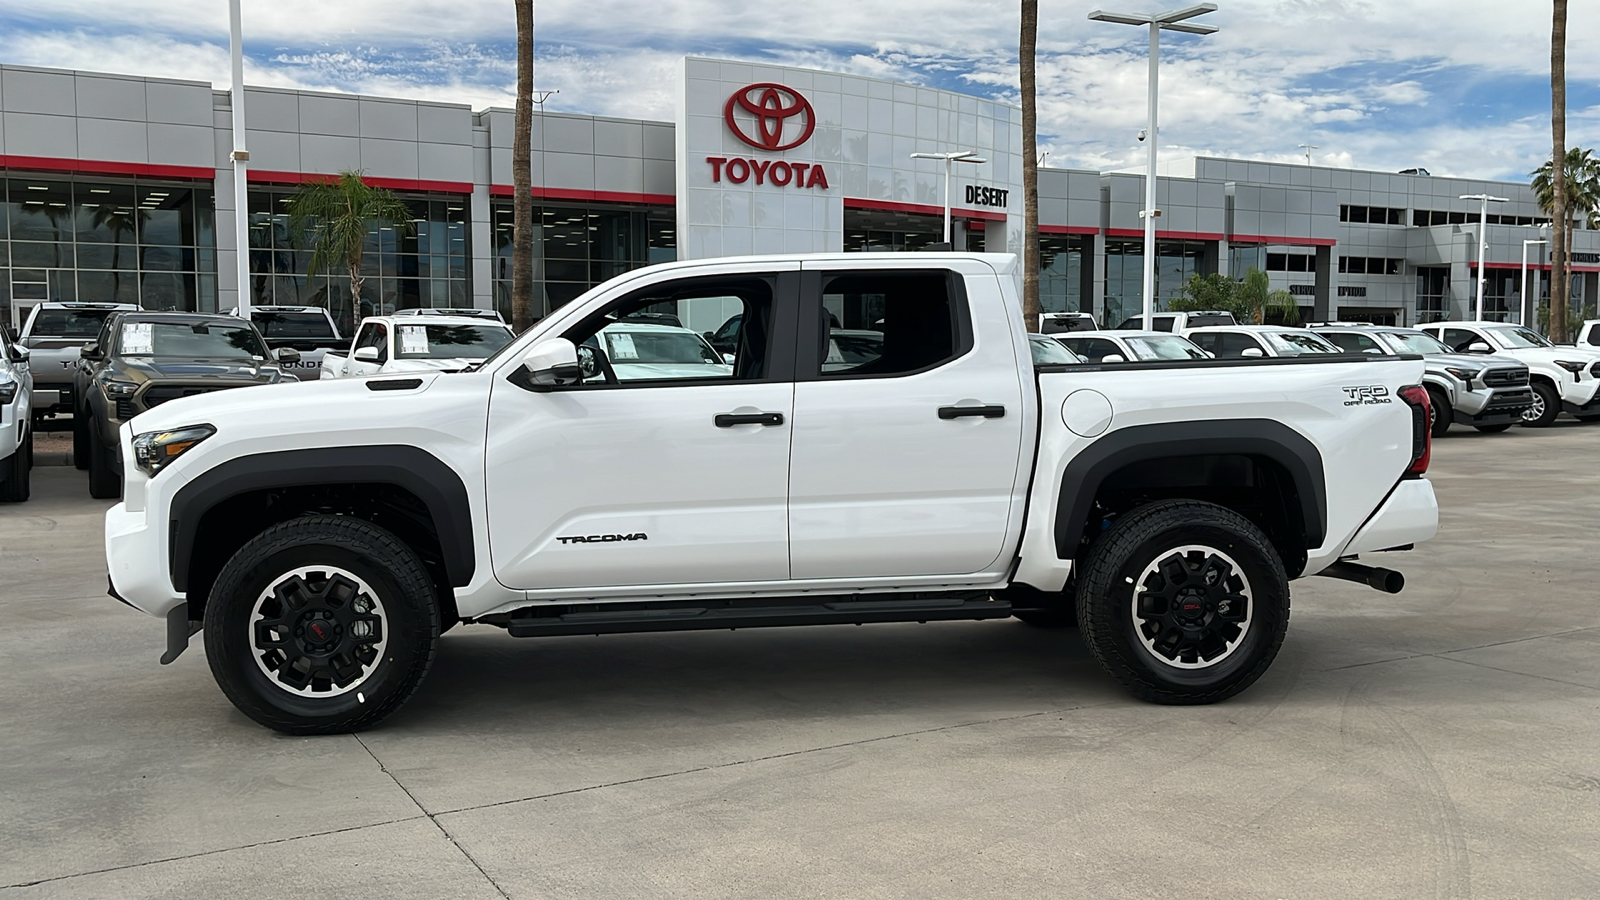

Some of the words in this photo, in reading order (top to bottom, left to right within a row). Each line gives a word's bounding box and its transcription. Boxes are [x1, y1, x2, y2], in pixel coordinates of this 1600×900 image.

[706, 157, 829, 189] TOYOTA
[965, 184, 1009, 208] DESERT
[1289, 284, 1315, 296] SERVI
[1337, 286, 1367, 297] EPTION
[1342, 385, 1389, 400] TRD
[556, 533, 648, 544] TACOMA
